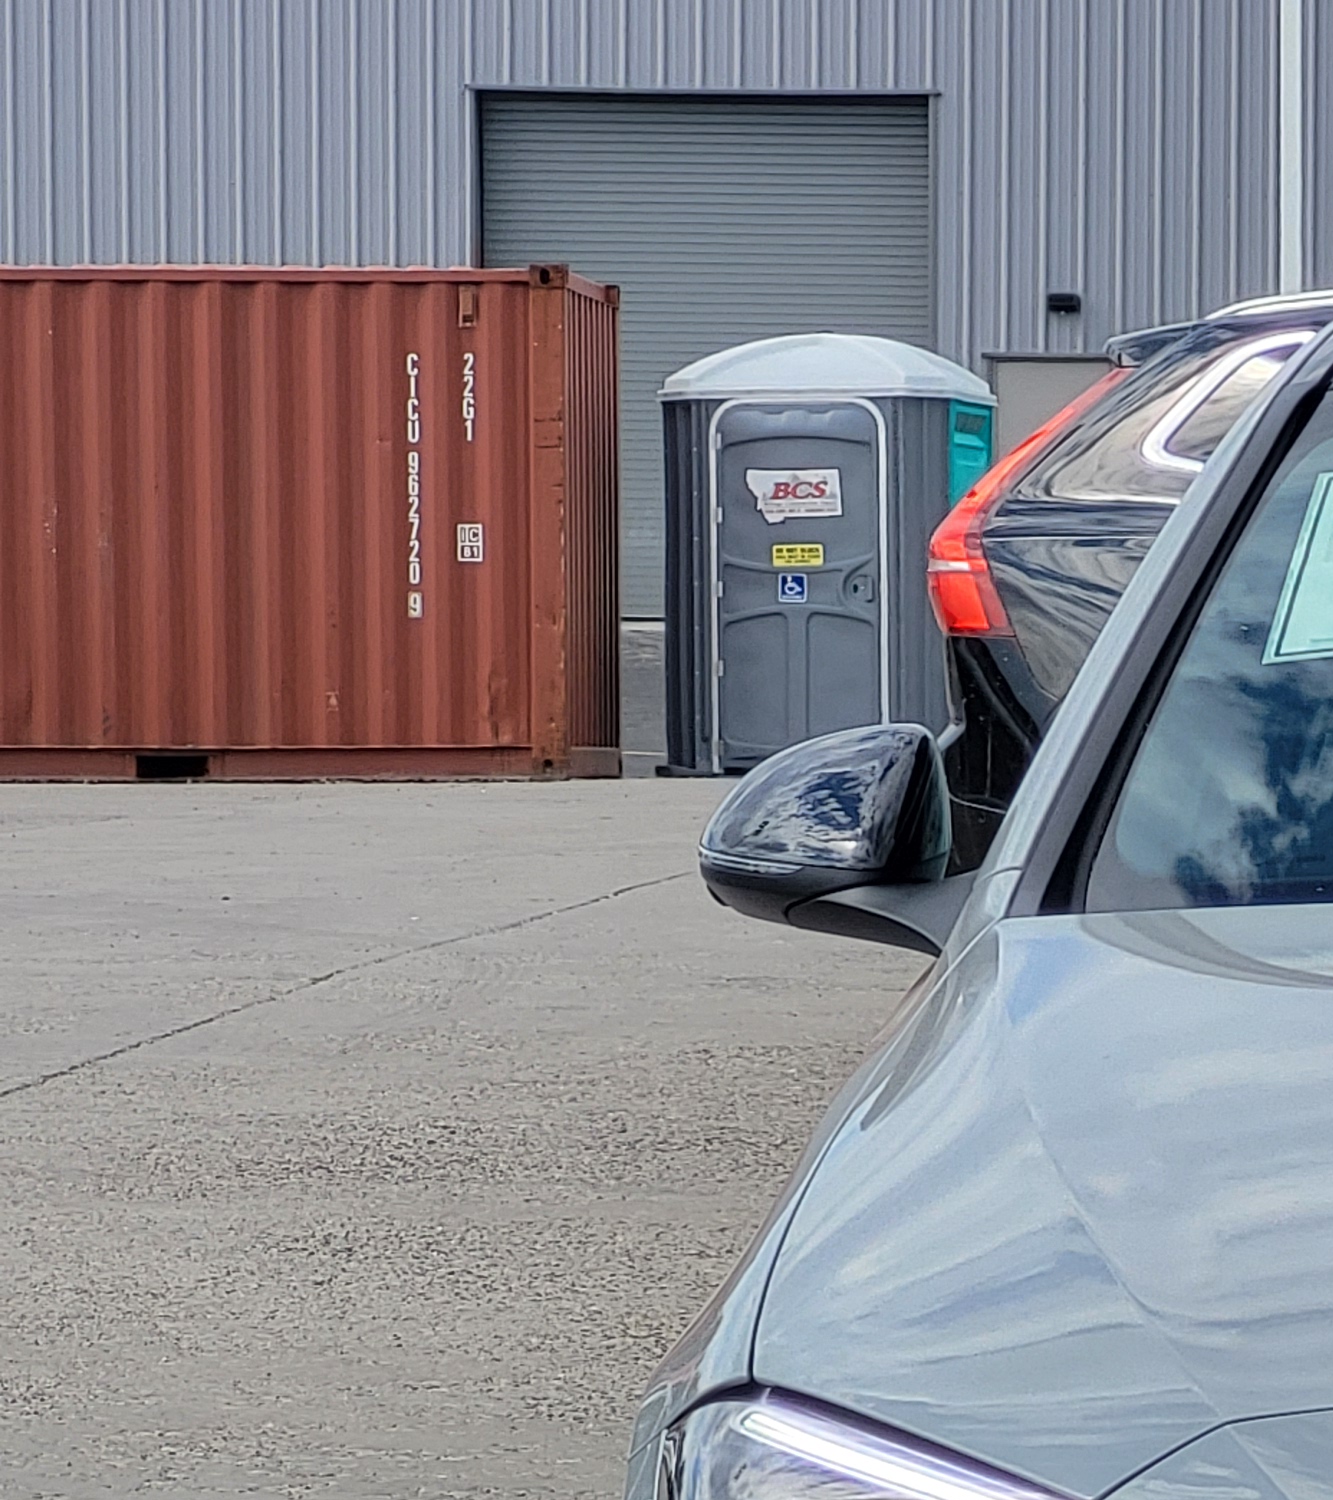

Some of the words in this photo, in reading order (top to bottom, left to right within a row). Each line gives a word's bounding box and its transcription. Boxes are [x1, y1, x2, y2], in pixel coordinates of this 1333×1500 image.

[406, 353, 419, 443] CICU
[462, 352, 475, 441] 22G1
[408, 451, 420, 584] 962720
[770, 480, 828, 500] BCS
[408, 592, 421, 613] 9
